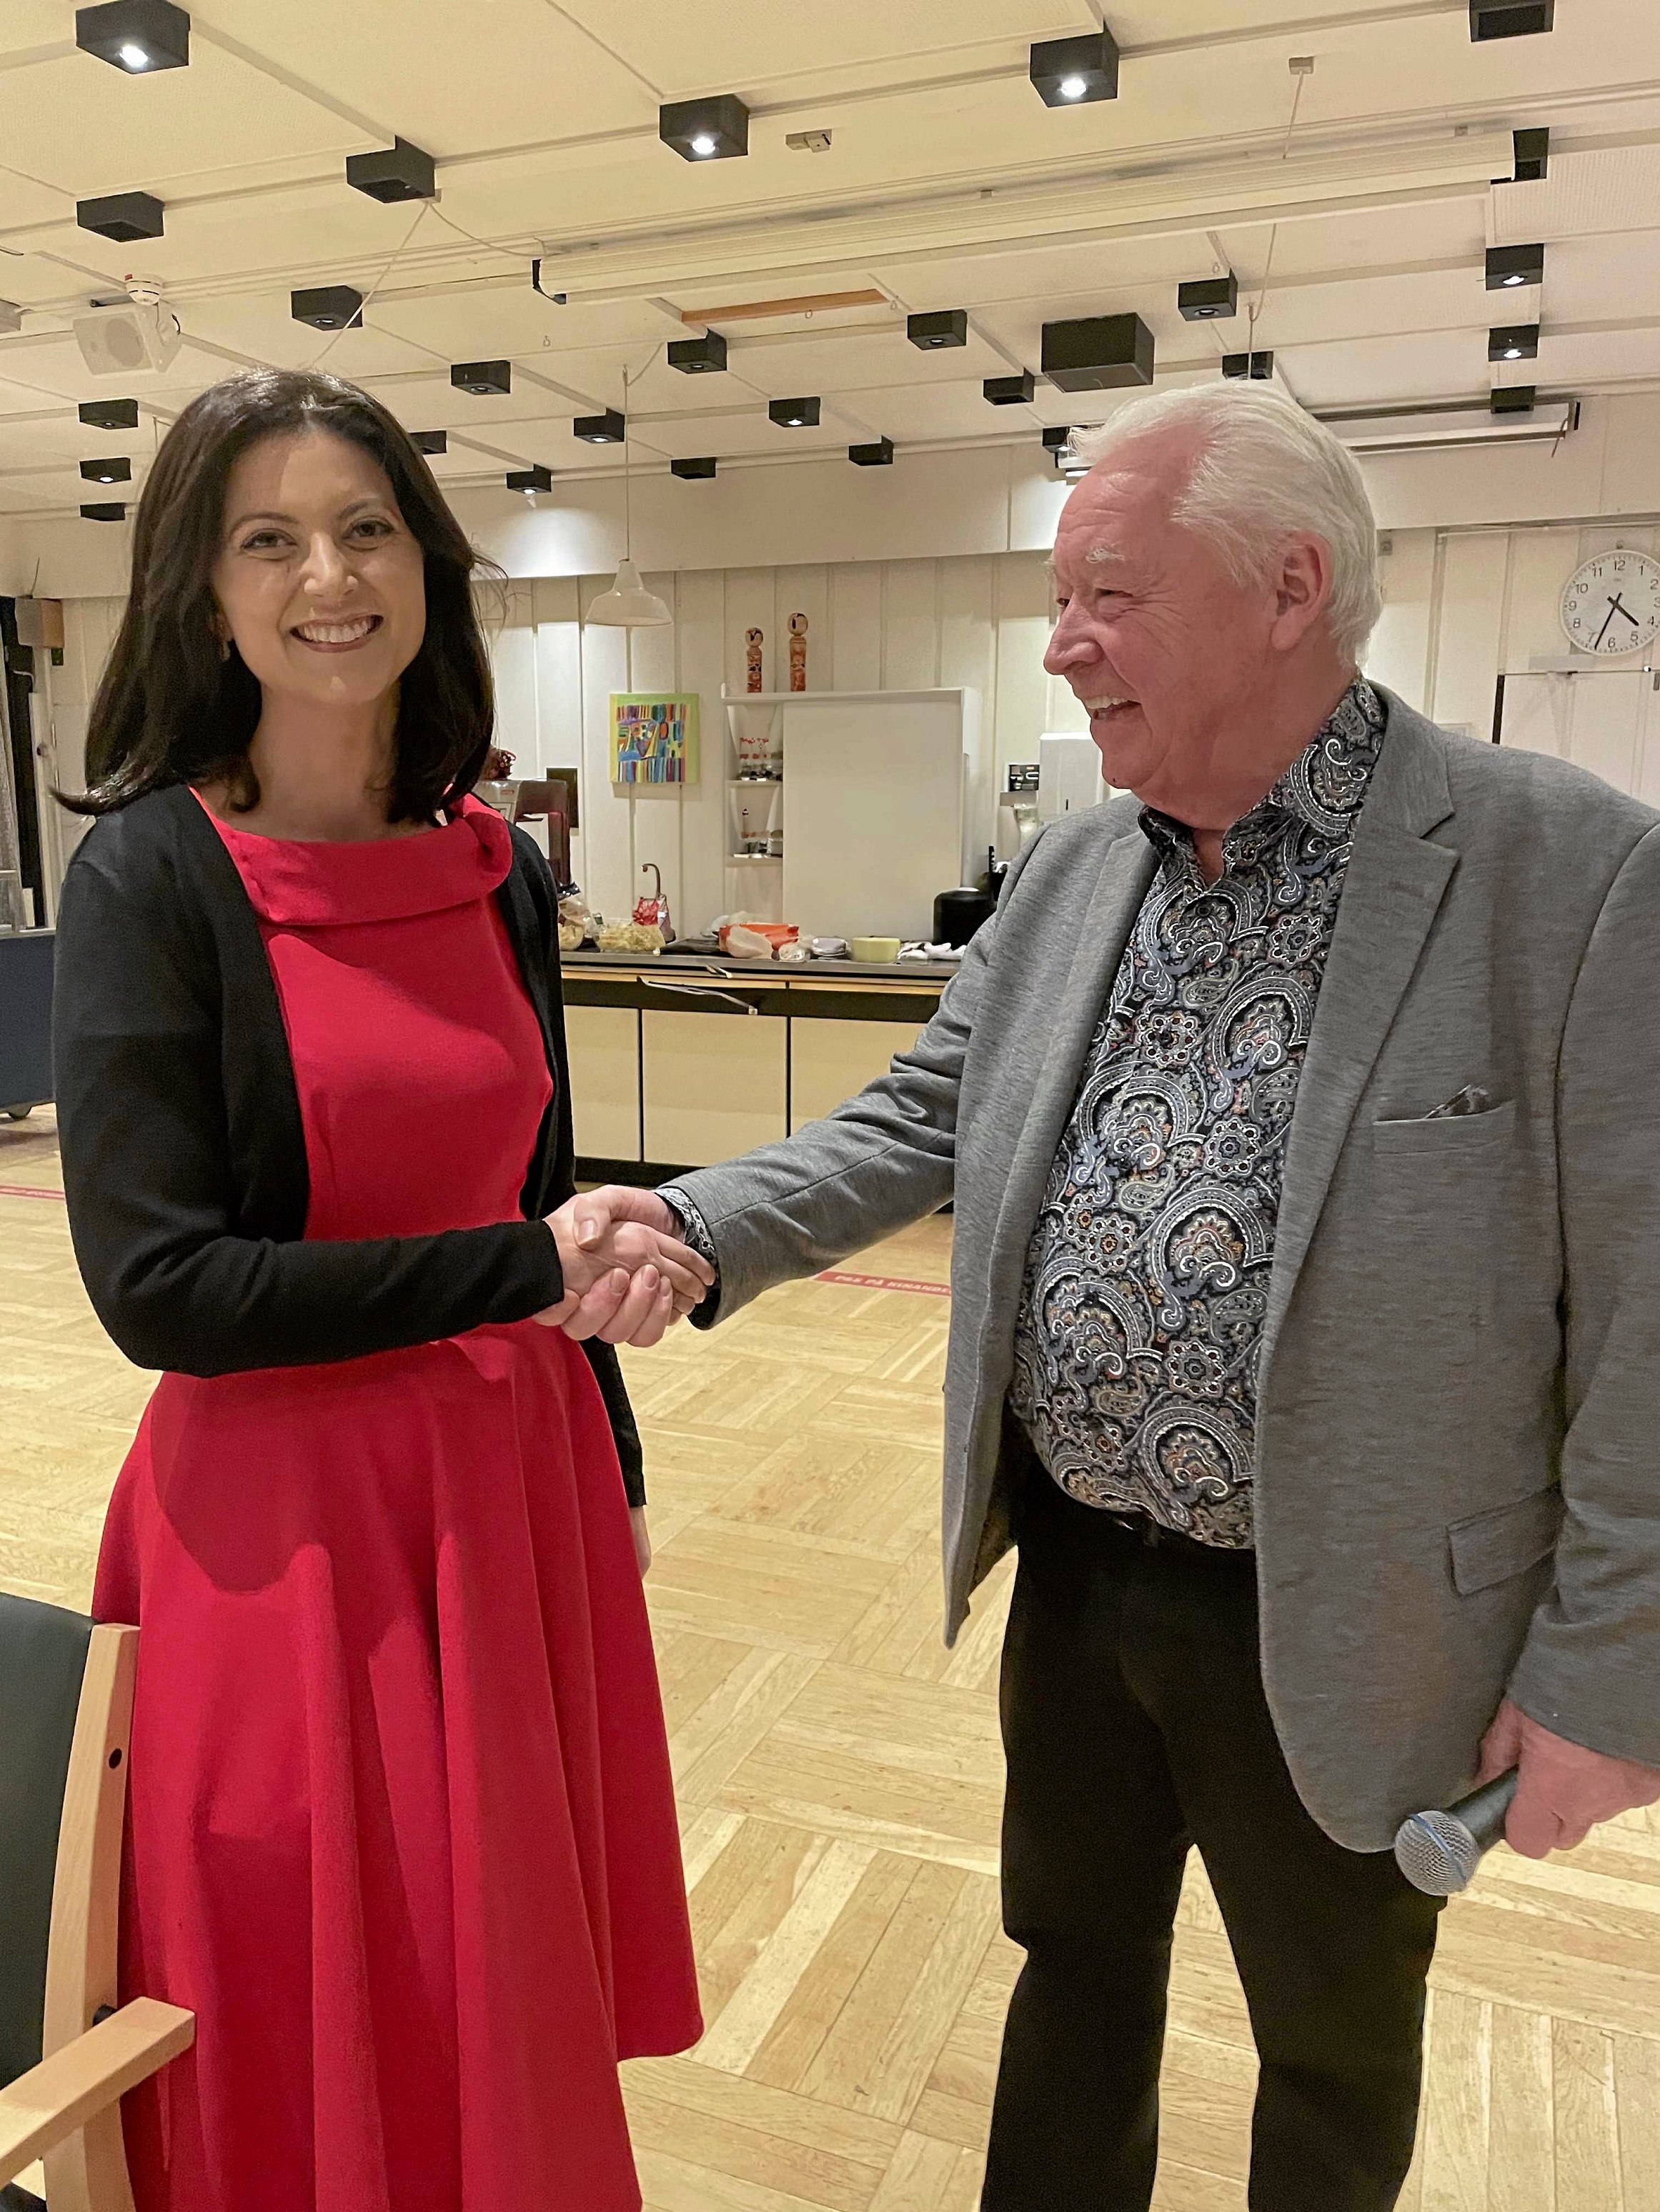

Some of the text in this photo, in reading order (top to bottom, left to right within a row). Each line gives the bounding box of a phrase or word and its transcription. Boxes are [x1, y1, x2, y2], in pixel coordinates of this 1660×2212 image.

[1614, 560, 1625, 571] 12
[1639, 565, 1644, 575] 1
[1593, 567, 1602, 577] 11
[1576, 583, 1588, 594] 10
[1650, 579, 1659, 590] 2
[1569, 600, 1576, 611] 9
[1573, 618, 1581, 628] 8
[1647, 616, 1654, 626] 4
[1588, 632, 1596, 642] 7
[1630, 631, 1638, 642] 5
[1608, 637, 1616, 647] 6
